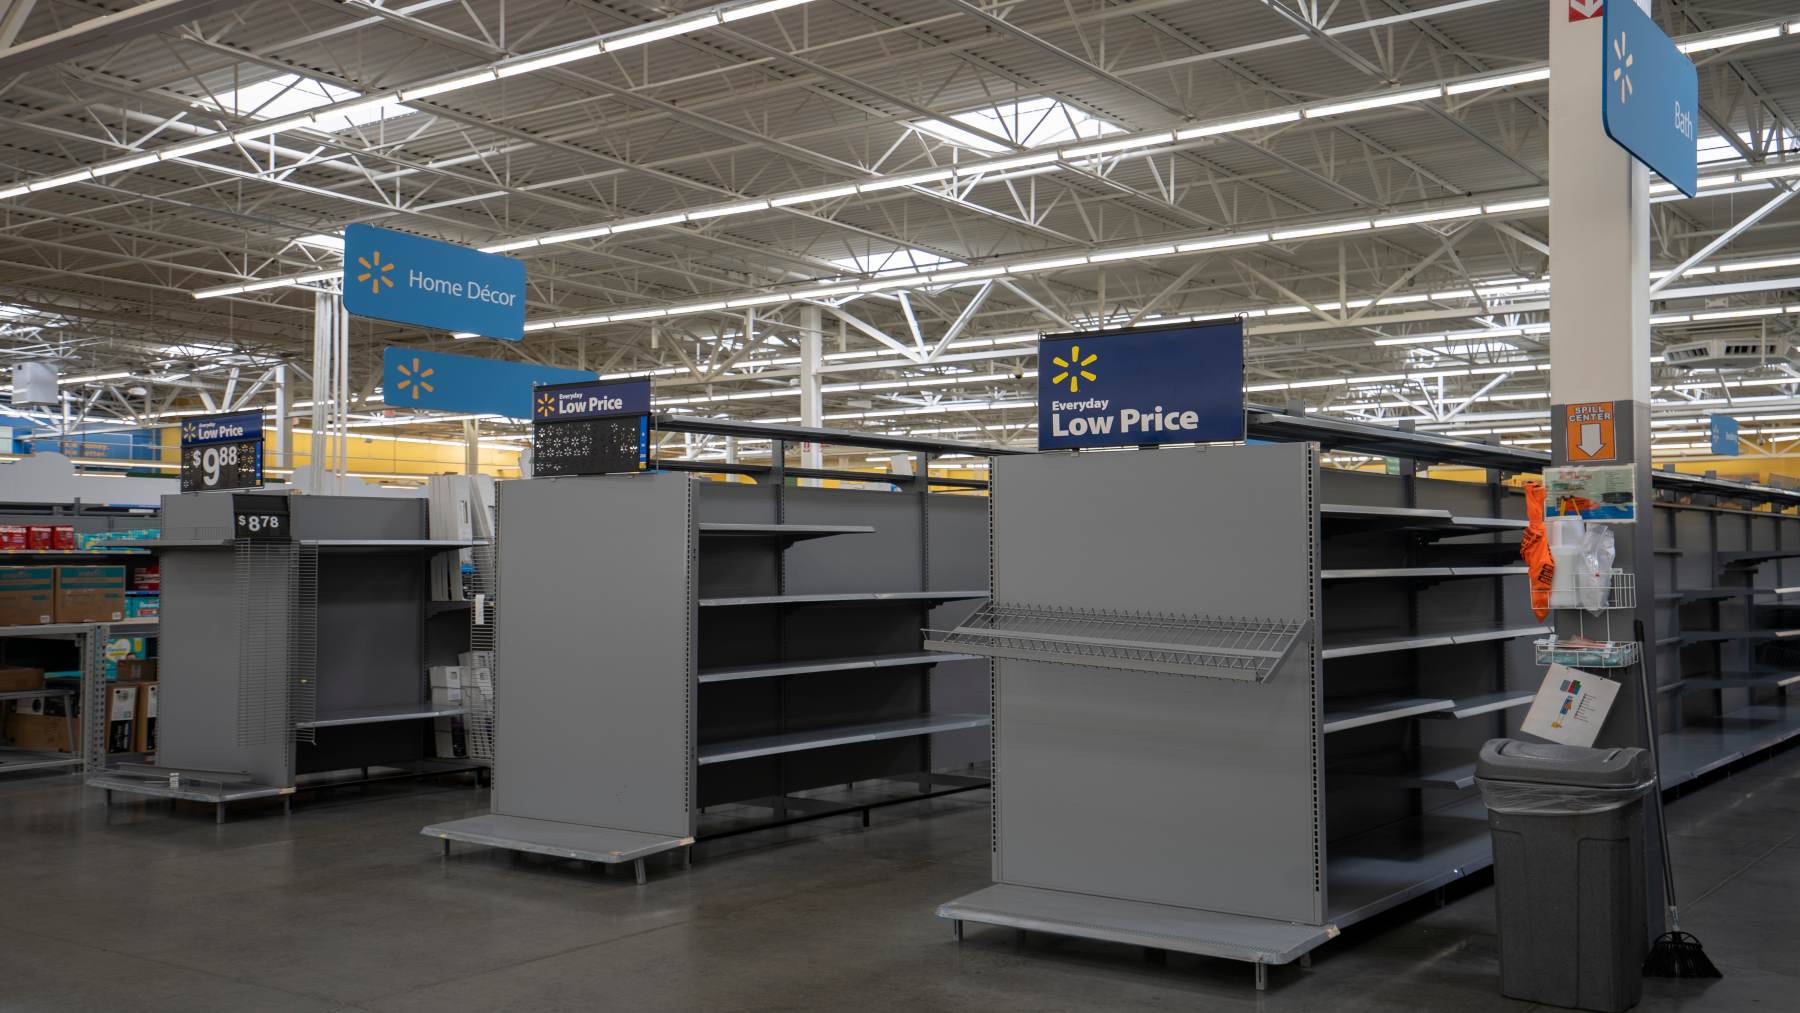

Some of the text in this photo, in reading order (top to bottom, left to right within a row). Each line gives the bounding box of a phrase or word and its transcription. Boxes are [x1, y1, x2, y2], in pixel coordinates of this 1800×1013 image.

[1674, 101, 1693, 141] Bath
[409, 269, 516, 306] Home Décor
[559, 392, 583, 400] Everyday
[559, 396, 623, 414] Low Price
[1052, 398, 1109, 412] Everyday
[1575, 406, 1605, 414] SPILL
[1052, 405, 1199, 437] Low Price
[1568, 413, 1611, 422] CENTER
[198, 424, 243, 440] Low Price
